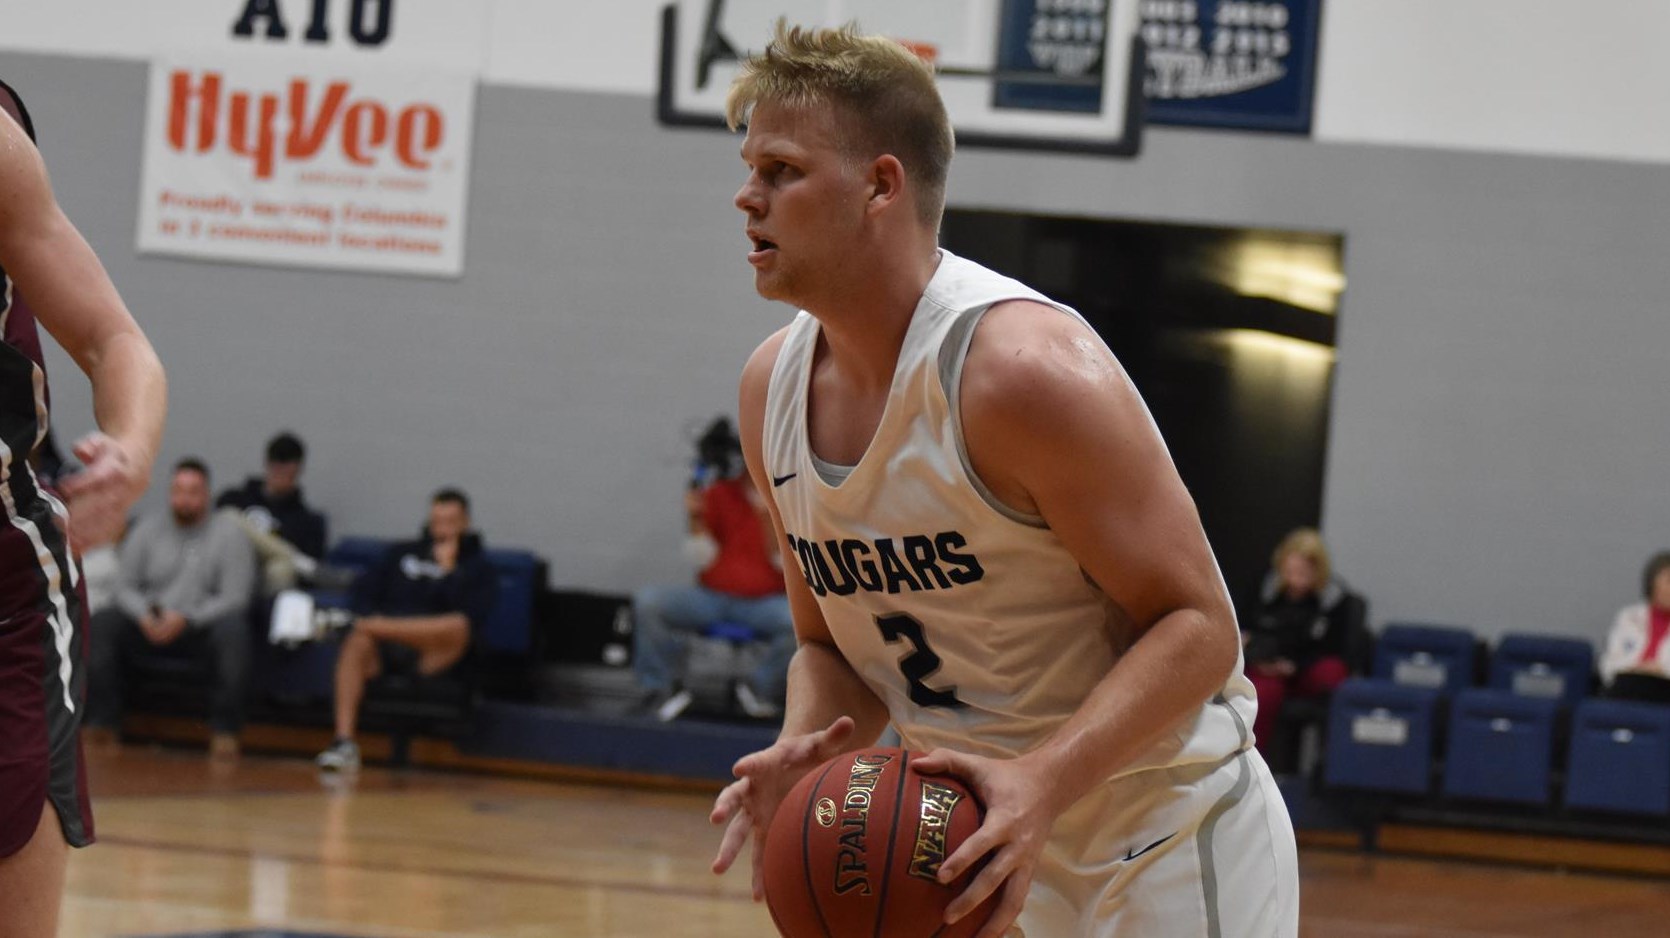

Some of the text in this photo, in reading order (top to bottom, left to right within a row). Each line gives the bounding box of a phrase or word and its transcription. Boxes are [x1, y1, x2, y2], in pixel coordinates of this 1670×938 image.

[166, 69, 446, 181] HyVee
[159, 190, 449, 230] Proudly serving Columbia
[339, 231, 444, 255] locations
[874, 611, 965, 708] 2
[833, 754, 894, 896] SPALDING
[908, 779, 963, 881] NAIA
